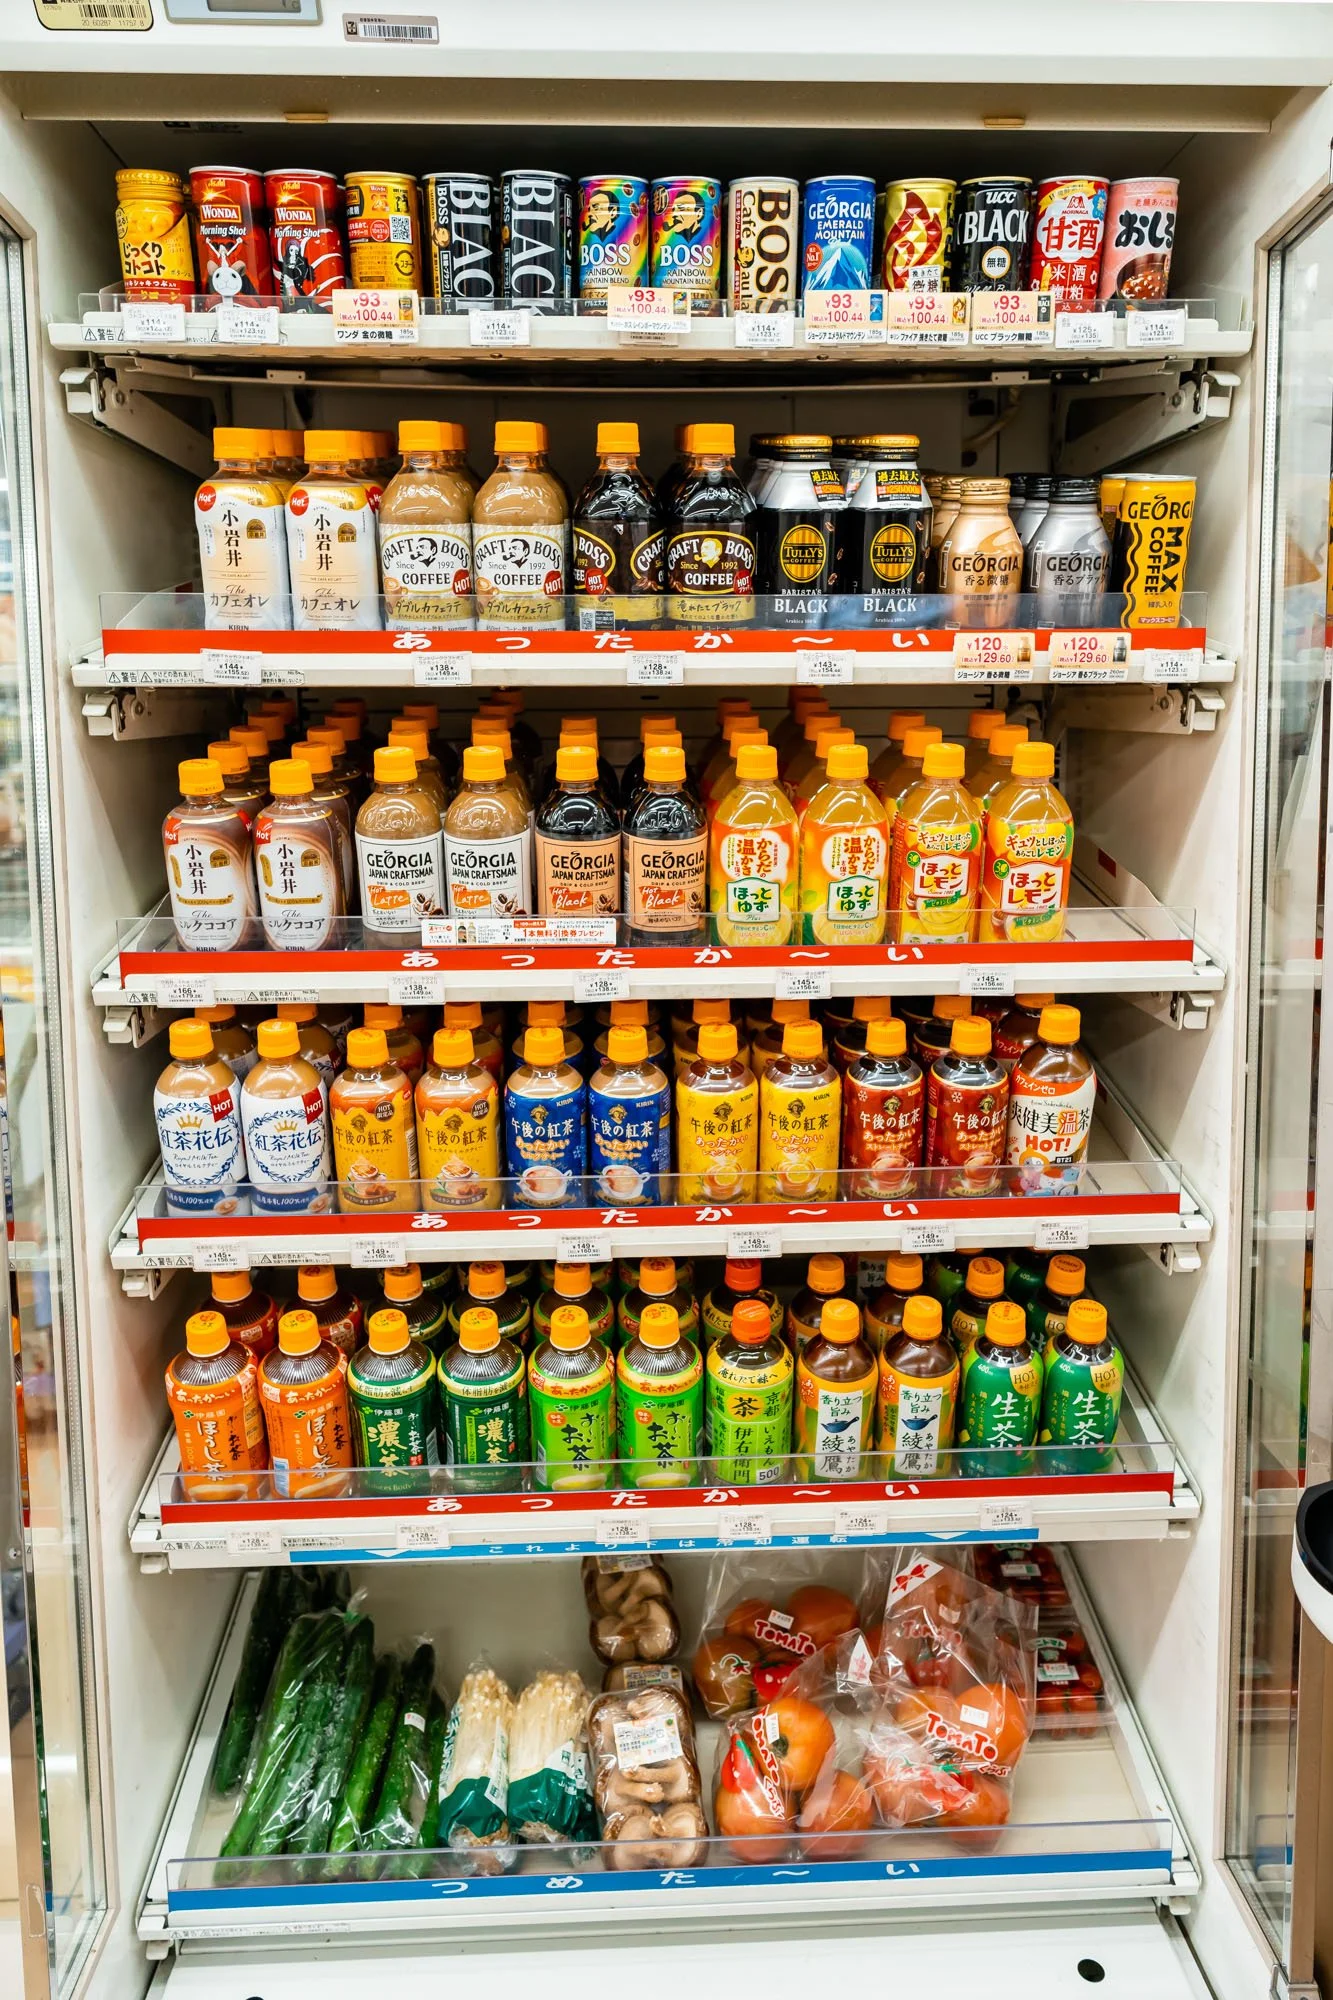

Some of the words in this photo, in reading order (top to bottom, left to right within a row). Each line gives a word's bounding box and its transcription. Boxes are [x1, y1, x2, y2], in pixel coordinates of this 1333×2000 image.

[986, 192, 1017, 203] UCC
[202, 205, 238, 218] WONDA
[438, 187, 448, 224] BOSS
[809, 195, 872, 220] GEORGIA
[276, 208, 312, 221] WONDA
[818, 221, 863, 230] EMERALD
[963, 210, 1029, 243] BLACK
[274, 228, 301, 238] Morning
[302, 229, 320, 237] Shot
[815, 230, 865, 239] MOUNTAIN
[1043, 216, 1100, 251] 甘酒
[123, 242, 162, 257] じっくり
[581, 244, 630, 265] BOSS
[660, 246, 713, 266] BOSS
[125, 261, 165, 275] コトコト
[987, 258, 1006, 268] 無糖
[667, 269, 706, 277] RAINBOW
[353, 293, 380, 307] ¥93
[629, 290, 655, 301] ¥93
[826, 294, 852, 308] ¥93
[909, 296, 935, 309] ¥93
[994, 296, 1020, 309] ¥93
[98, 329, 114, 340] 警告
[362, 331, 392, 339] 金の微糖
[992, 333, 1032, 341] ブラック無糖
[222, 510, 242, 567] 小岩井
[315, 514, 333, 570] 小岩井
[383, 539, 413, 569] CRAFT
[441, 540, 469, 569] BOSS
[476, 540, 507, 569] CRAFT
[534, 540, 561, 569] BOSS
[579, 537, 609, 569] BOSS
[668, 539, 699, 569] CRAFT
[725, 541, 753, 569] BOSS
[1159, 526, 1184, 593] MAX
[681, 562, 698, 570] Since
[1144, 528, 1164, 594] COFFEE
[402, 573, 450, 584] COFFEE
[454, 577, 470, 592] HOT
[494, 574, 541, 585] COFFEE
[546, 578, 562, 593] HOT
[686, 574, 733, 585] COFFEE
[964, 575, 1009, 586] 香る微糖
[211, 595, 270, 607] カフェオレ
[301, 599, 360, 611] カフェオレ
[396, 601, 461, 613] ダブルカフェラテ
[487, 601, 551, 613] ダブルカフェラテ
[677, 600, 741, 612] 淹れたてブラック
[775, 599, 827, 613] BLACK
[864, 598, 917, 612] BLACK
[967, 637, 1001, 650] ¥120
[1064, 637, 1097, 650] ¥120
[122, 672, 137, 683] 警告
[367, 850, 432, 868] GEORGIA
[451, 850, 516, 868] GEORGIA
[551, 851, 615, 869] GEORGIA
[641, 851, 704, 869] GEORGIA
[186, 845, 207, 894] 小岩井
[278, 844, 297, 894] 小岩井
[369, 868, 388, 879] JAPAN
[390, 867, 433, 879] CRAFTSMAN
[452, 868, 469, 878] JAPAN
[472, 867, 517, 879] CRAFTSMAN
[552, 870, 573, 880] JAPAN
[575, 869, 615, 880] CRAFTSMAN
[642, 869, 665, 878] JAPAN
[668, 867, 704, 879] CRAFTSMAN
[922, 863, 962, 876] ほっと
[919, 876, 963, 890] レモン
[1011, 873, 1056, 887] ほっと
[734, 887, 772, 900] ほっと
[837, 886, 873, 897] ほっと
[1008, 888, 1057, 905] レモン
[738, 901, 769, 912] ゆず
[840, 899, 871, 912] ゆず
[141, 993, 157, 1002] 警告
[1015, 1074, 1056, 1095] カフェインゼロ
[213, 1100, 231, 1113] HOT
[306, 1100, 322, 1114] HOT
[556, 1098, 573, 1107] KIRIN
[691, 1113, 753, 1135] 午後の紅茶
[768, 1112, 830, 1132] 午後の紅茶
[859, 1108, 921, 1130] 午後の紅茶
[952, 1106, 1007, 1130] 午後の紅茶
[511, 1117, 574, 1139] 午後の紅茶
[591, 1116, 653, 1138] 午後の紅茶
[160, 1124, 233, 1151] 紅茶花伝
[254, 1127, 321, 1151] 紅茶花伝
[335, 1128, 393, 1146] 午後の紅茶
[425, 1126, 487, 1147] 午後の紅茶
[695, 1136, 748, 1147] あったかい
[771, 1132, 824, 1145] あったかい
[515, 1137, 569, 1151] あったかい
[1014, 1370, 1035, 1384] HOT
[1094, 1368, 1117, 1382] HOT
[821, 1394, 862, 1406] 香り立つ
[901, 1390, 942, 1402] 香り立つ
[732, 1397, 760, 1418] 茶
[764, 1392, 780, 1417] 京都
[830, 1407, 851, 1416] 旨み
[911, 1402, 930, 1414] 旨み
[374, 1408, 403, 1416] 伊藤園
[197, 1420, 225, 1481] ほうじ茶
[367, 1419, 409, 1477] 濃い茶
[764, 1426, 775, 1467] いえもん
[901, 1432, 922, 1472] 綾鷹
[820, 1436, 844, 1474] 綾鷹
[758, 1467, 779, 1480] 500
[754, 1619, 816, 1657] TOMATO
[926, 1711, 998, 1762] TOMATO
